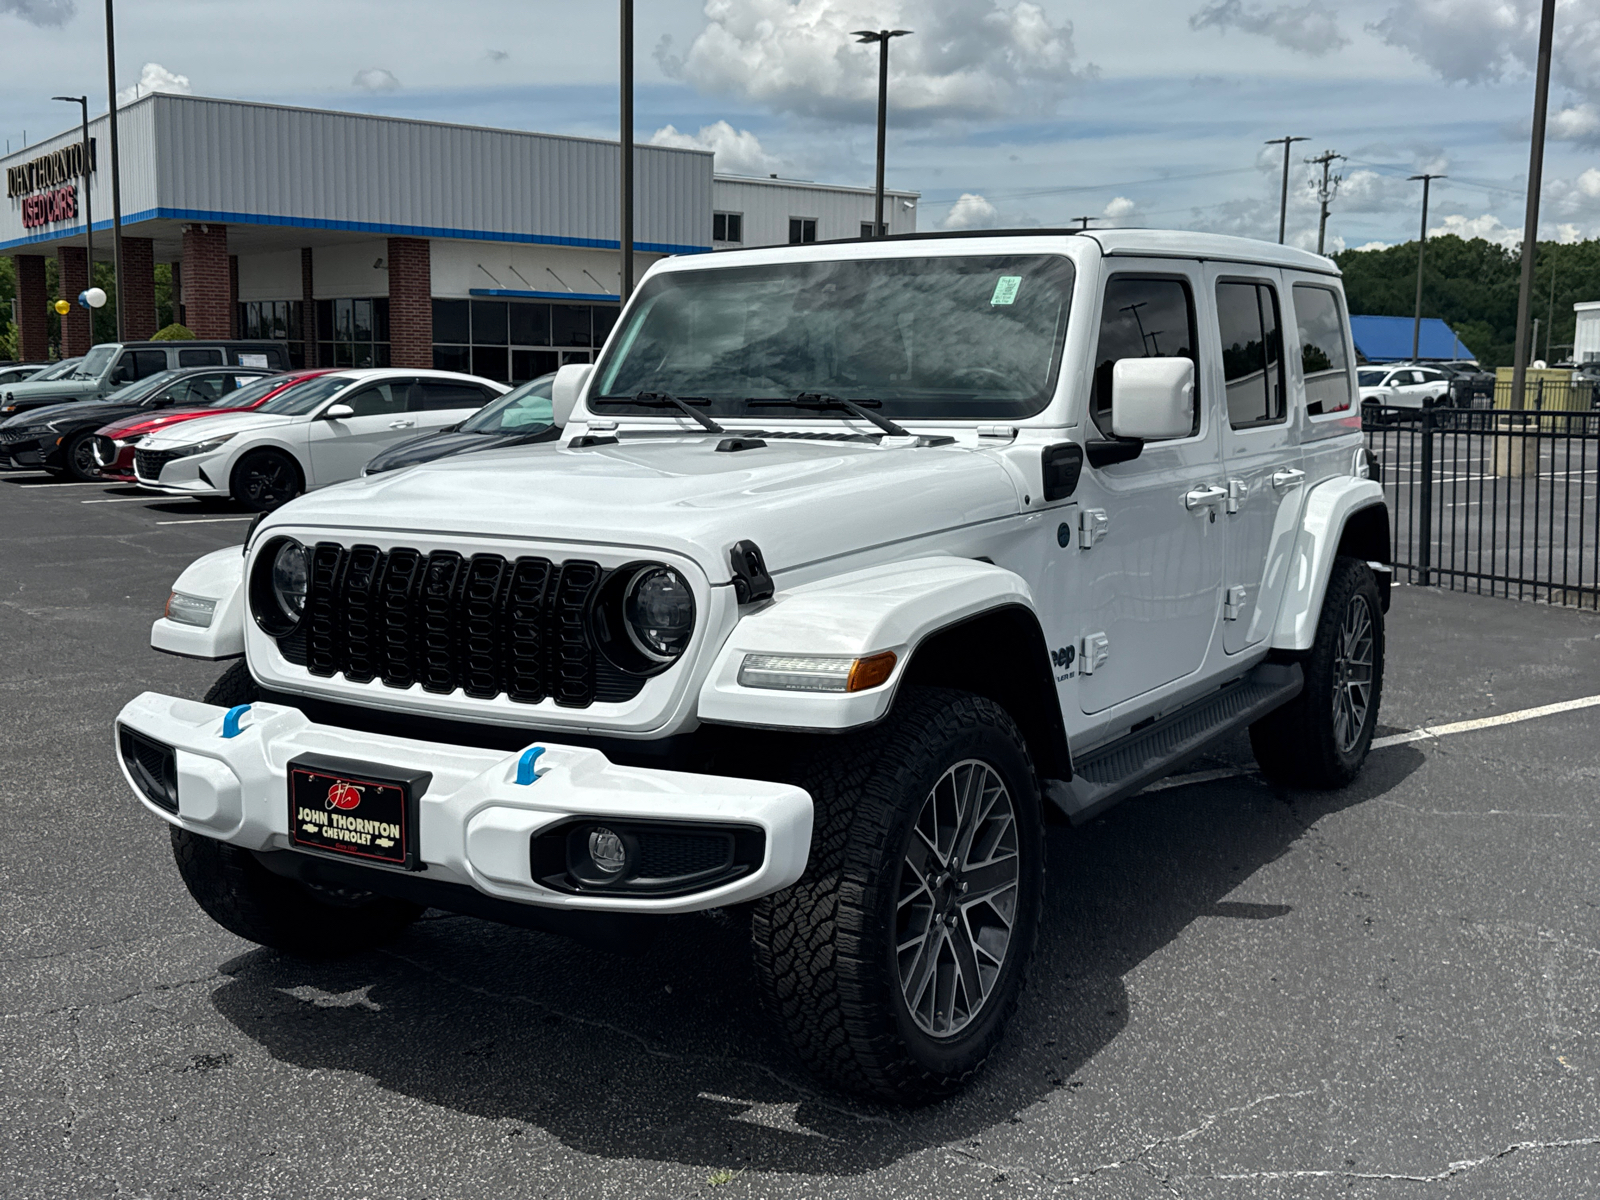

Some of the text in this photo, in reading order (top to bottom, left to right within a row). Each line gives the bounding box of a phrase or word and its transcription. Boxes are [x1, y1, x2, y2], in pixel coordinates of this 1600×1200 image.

[6, 162, 33, 198] JOHN
[22, 185, 77, 229] USED CARS
[1050, 644, 1076, 670] eep
[298, 807, 400, 839] JOHN THORNTON
[322, 826, 371, 845] CHEVROLET
